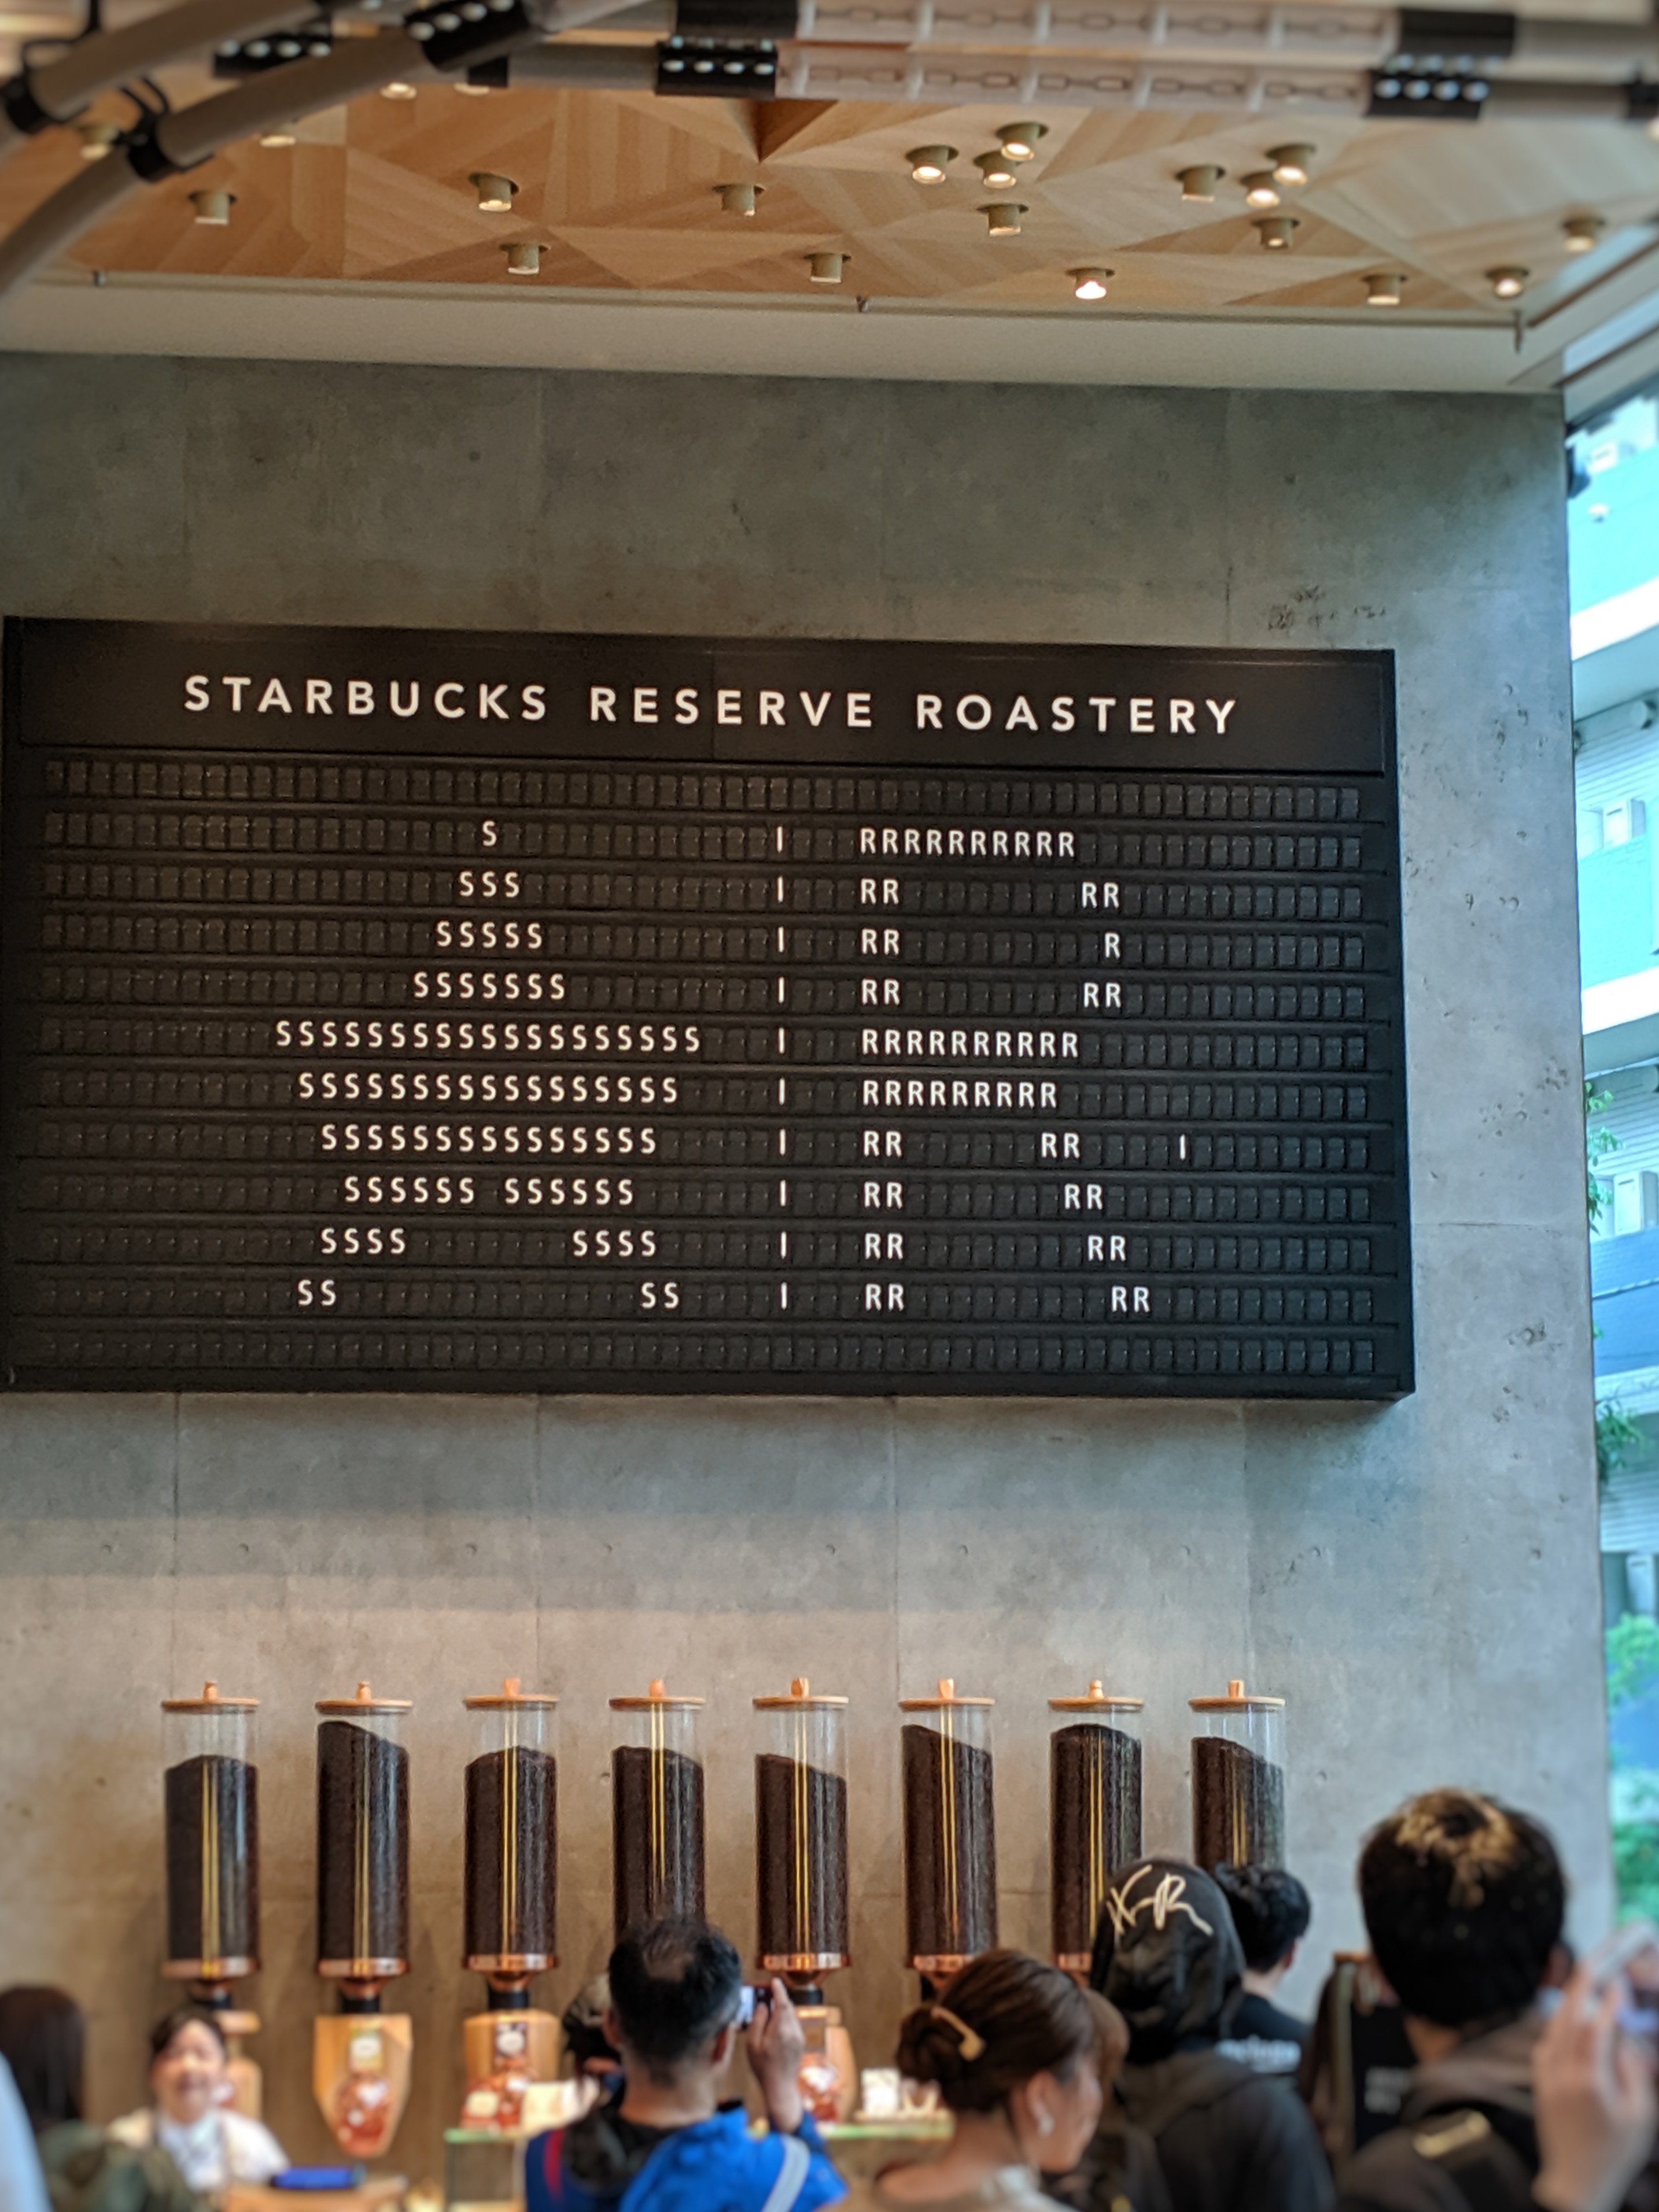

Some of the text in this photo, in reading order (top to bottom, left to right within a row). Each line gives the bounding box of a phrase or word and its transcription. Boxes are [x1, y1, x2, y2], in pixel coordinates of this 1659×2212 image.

[184, 674, 1236, 734] STARBUCKS RESERVE ROASTERY
[482, 820, 497, 847] S
[860, 828, 1075, 857] RRRRRRRRRR
[459, 871, 520, 898] SSS
[860, 878, 899, 904] RR
[1081, 881, 1120, 909] RR
[437, 921, 543, 950] SSSSS
[861, 928, 899, 955] RR
[1104, 932, 1120, 958] R
[414, 971, 565, 1000] SSSSSSS
[861, 978, 901, 1005] RR
[1083, 981, 1122, 1009] RR
[276, 1020, 700, 1053] SSSSSSSSSSSSSSSSSSS
[862, 1028, 1078, 1058] RRRRRRRRRR
[298, 1072, 677, 1103] SSSSSSSSSSSSSSSSS
[862, 1079, 1057, 1109] RRRRRRRRR
[322, 1124, 657, 1154] SSSSSSSSSSSSSSS
[863, 1130, 902, 1157] RR
[1041, 1132, 1081, 1159] RR
[344, 1176, 474, 1204] SSSSSS
[504, 1177, 633, 1206] SSSSSS
[864, 1181, 903, 1209] RR
[1064, 1183, 1103, 1210] RR
[320, 1227, 406, 1255] SSSS
[573, 1229, 656, 1257] SSSS
[864, 1232, 904, 1260] RR
[1087, 1234, 1126, 1261] RR
[297, 1279, 337, 1306] SS
[641, 1282, 679, 1309] SS
[865, 1283, 905, 1311] RR
[1111, 1286, 1150, 1313] RR
